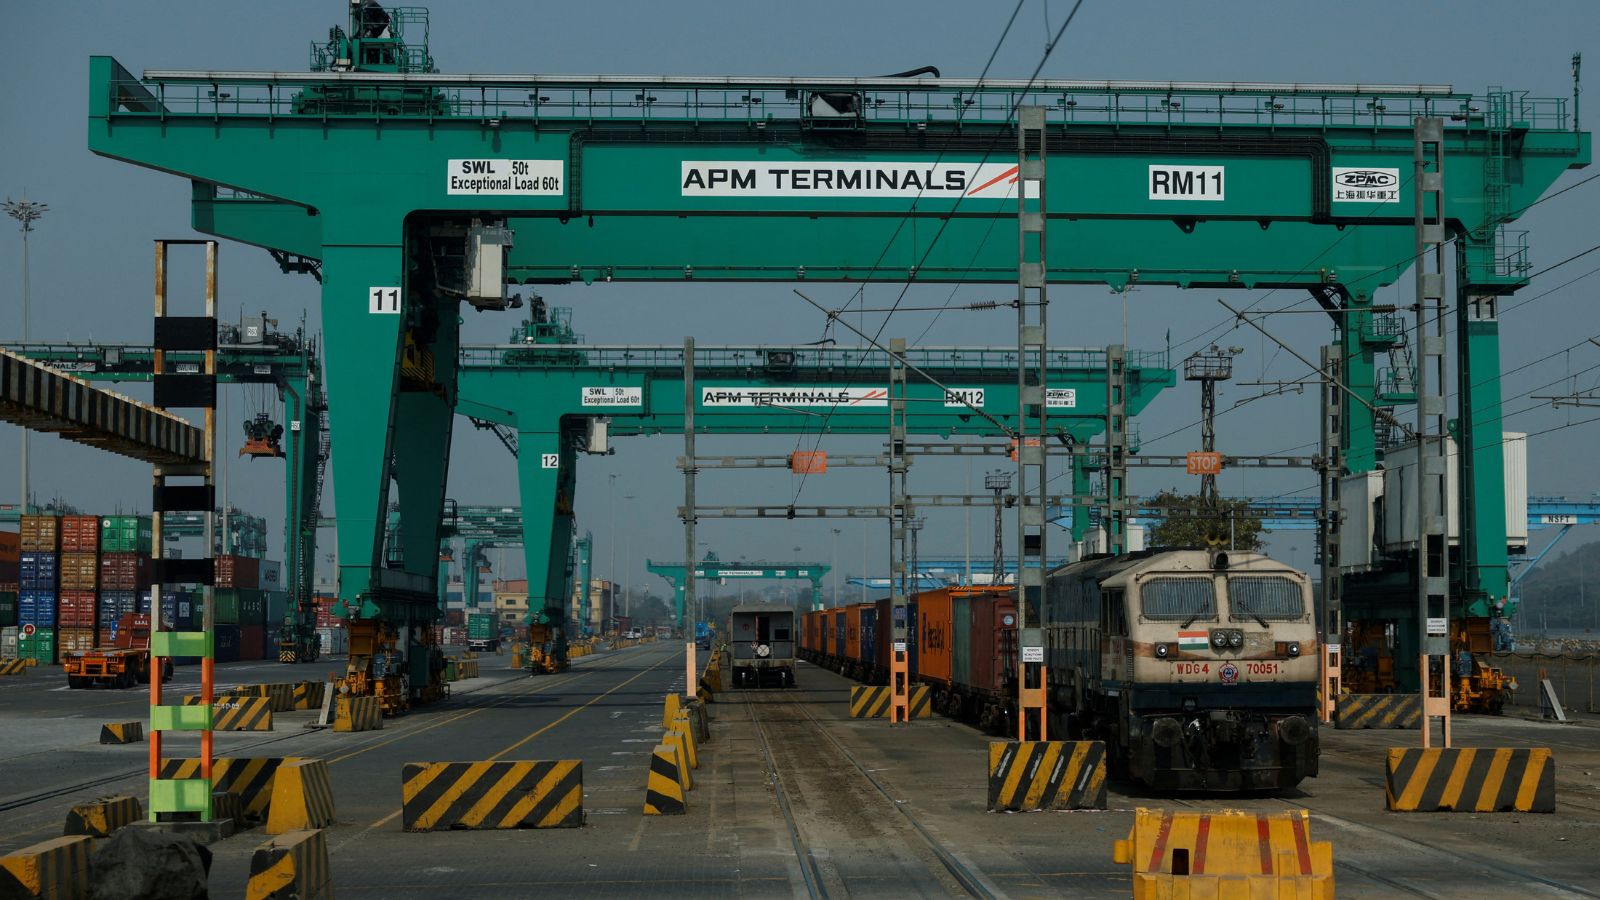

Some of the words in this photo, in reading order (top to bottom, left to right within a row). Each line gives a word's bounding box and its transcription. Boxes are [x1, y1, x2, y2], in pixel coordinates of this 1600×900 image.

[462, 160, 495, 174] SWL
[512, 161, 529, 176] 50t
[451, 175, 511, 193] Exceptional
[514, 176, 539, 190] Load
[542, 177, 559, 191] 60t
[682, 168, 757, 189] APM
[768, 169, 966, 190] TERMINALS
[1152, 170, 1222, 195] RM11
[1345, 175, 1389, 184] ZPMC
[373, 289, 398, 311] 11
[1470, 297, 1495, 318] 11
[589, 388, 606, 396] SWL
[615, 388, 625, 396] 50t
[704, 392, 742, 403] APM
[747, 392, 849, 403] TERMINALS
[945, 390, 984, 404] RM12
[584, 395, 615, 405] Exceptional
[616, 395, 630, 404] Load
[630, 395, 640, 404] 60t
[543, 455, 558, 466] 12
[1190, 456, 1218, 470] STOP
[1548, 515, 1570, 523] NSFT
[1177, 663, 1209, 674] WDG4
[1246, 663, 1279, 674] 70051
